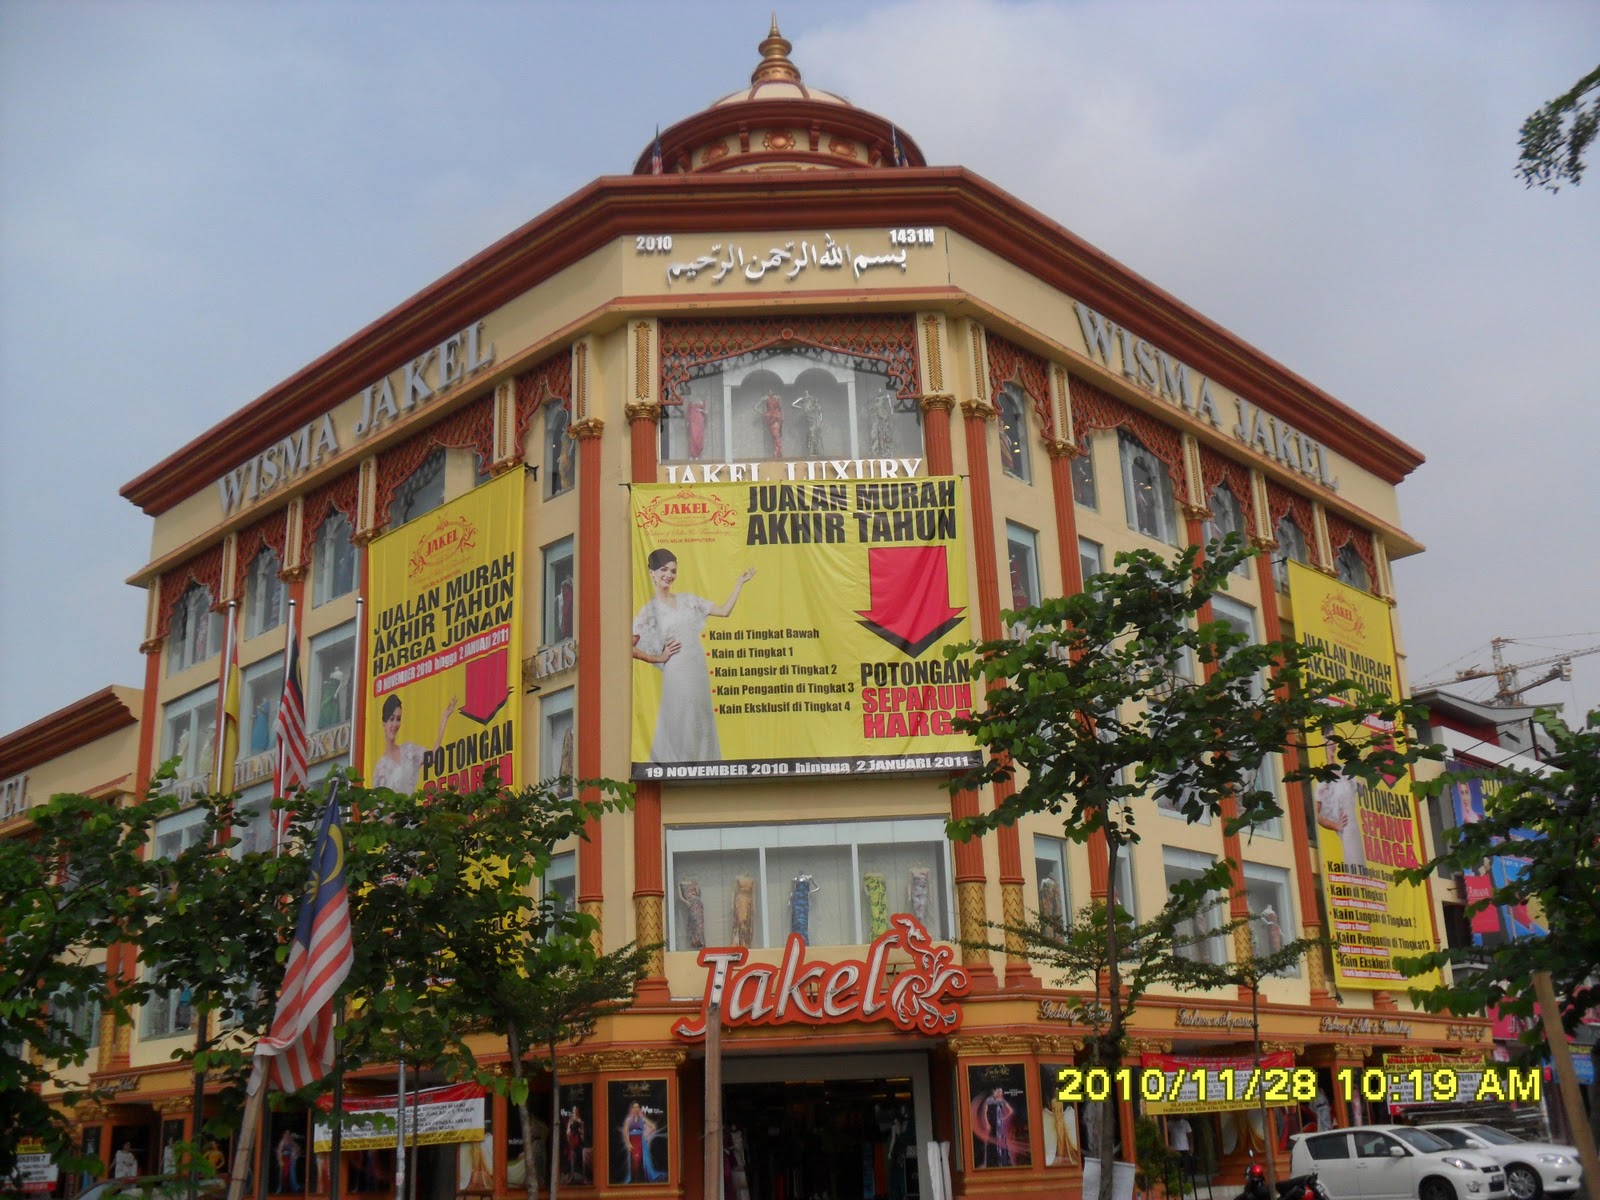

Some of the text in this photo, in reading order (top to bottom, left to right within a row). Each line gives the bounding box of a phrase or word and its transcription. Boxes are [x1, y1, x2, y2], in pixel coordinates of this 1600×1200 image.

[636, 235, 673, 251] 2010
[889, 228, 935, 244] 1431H
[1074, 301, 1340, 492] WISMA JAKEL
[216, 321, 495, 514] WISMA JAKEL
[784, 458, 923, 481] LUXURY
[661, 503, 710, 516] JAKEL
[747, 479, 956, 514] JUALAN MURAH
[746, 507, 957, 546] AKHIR TAHUN
[426, 529, 459, 556] JAKEL
[374, 586, 440, 635] JUALAN
[446, 551, 515, 603] MURAH
[373, 575, 514, 658] AKHIR TAHUN
[373, 600, 513, 677] HARGA JUNAM
[709, 628, 820, 642] Kain di Tingkat Bawah
[712, 646, 794, 659] Kain di Tingkat 1
[715, 664, 837, 678] Kain Langsir di Tingkat 2
[860, 659, 971, 687] POTONGAN
[1350, 651, 1392, 682] MURAH
[717, 682, 855, 697] Kain Pengantin di Tingkat 3
[861, 683, 973, 713] SEPARUH
[719, 701, 851, 714] Kain Eksklusif di Tingkat 4
[423, 720, 513, 782] POTONGAN
[645, 755, 969, 778] 19 NOVEMBER 2010 hingga 2 JANUARI 2011
[1356, 783, 1412, 819] POTONGAN
[1360, 808, 1414, 844] SEPARUH
[1363, 835, 1420, 870] HARGA
[1327, 861, 1350, 874] Kain
[1330, 885, 1351, 898] Kain
[1333, 908, 1354, 920] Kain
[1387, 914, 1412, 928] Tingkat
[1336, 932, 1356, 944] Kain
[1399, 938, 1424, 950] Tingkat
[1425, 940, 1431, 950] 3
[1340, 954, 1358, 967] Kain
[676, 933, 901, 1038] Jakel
